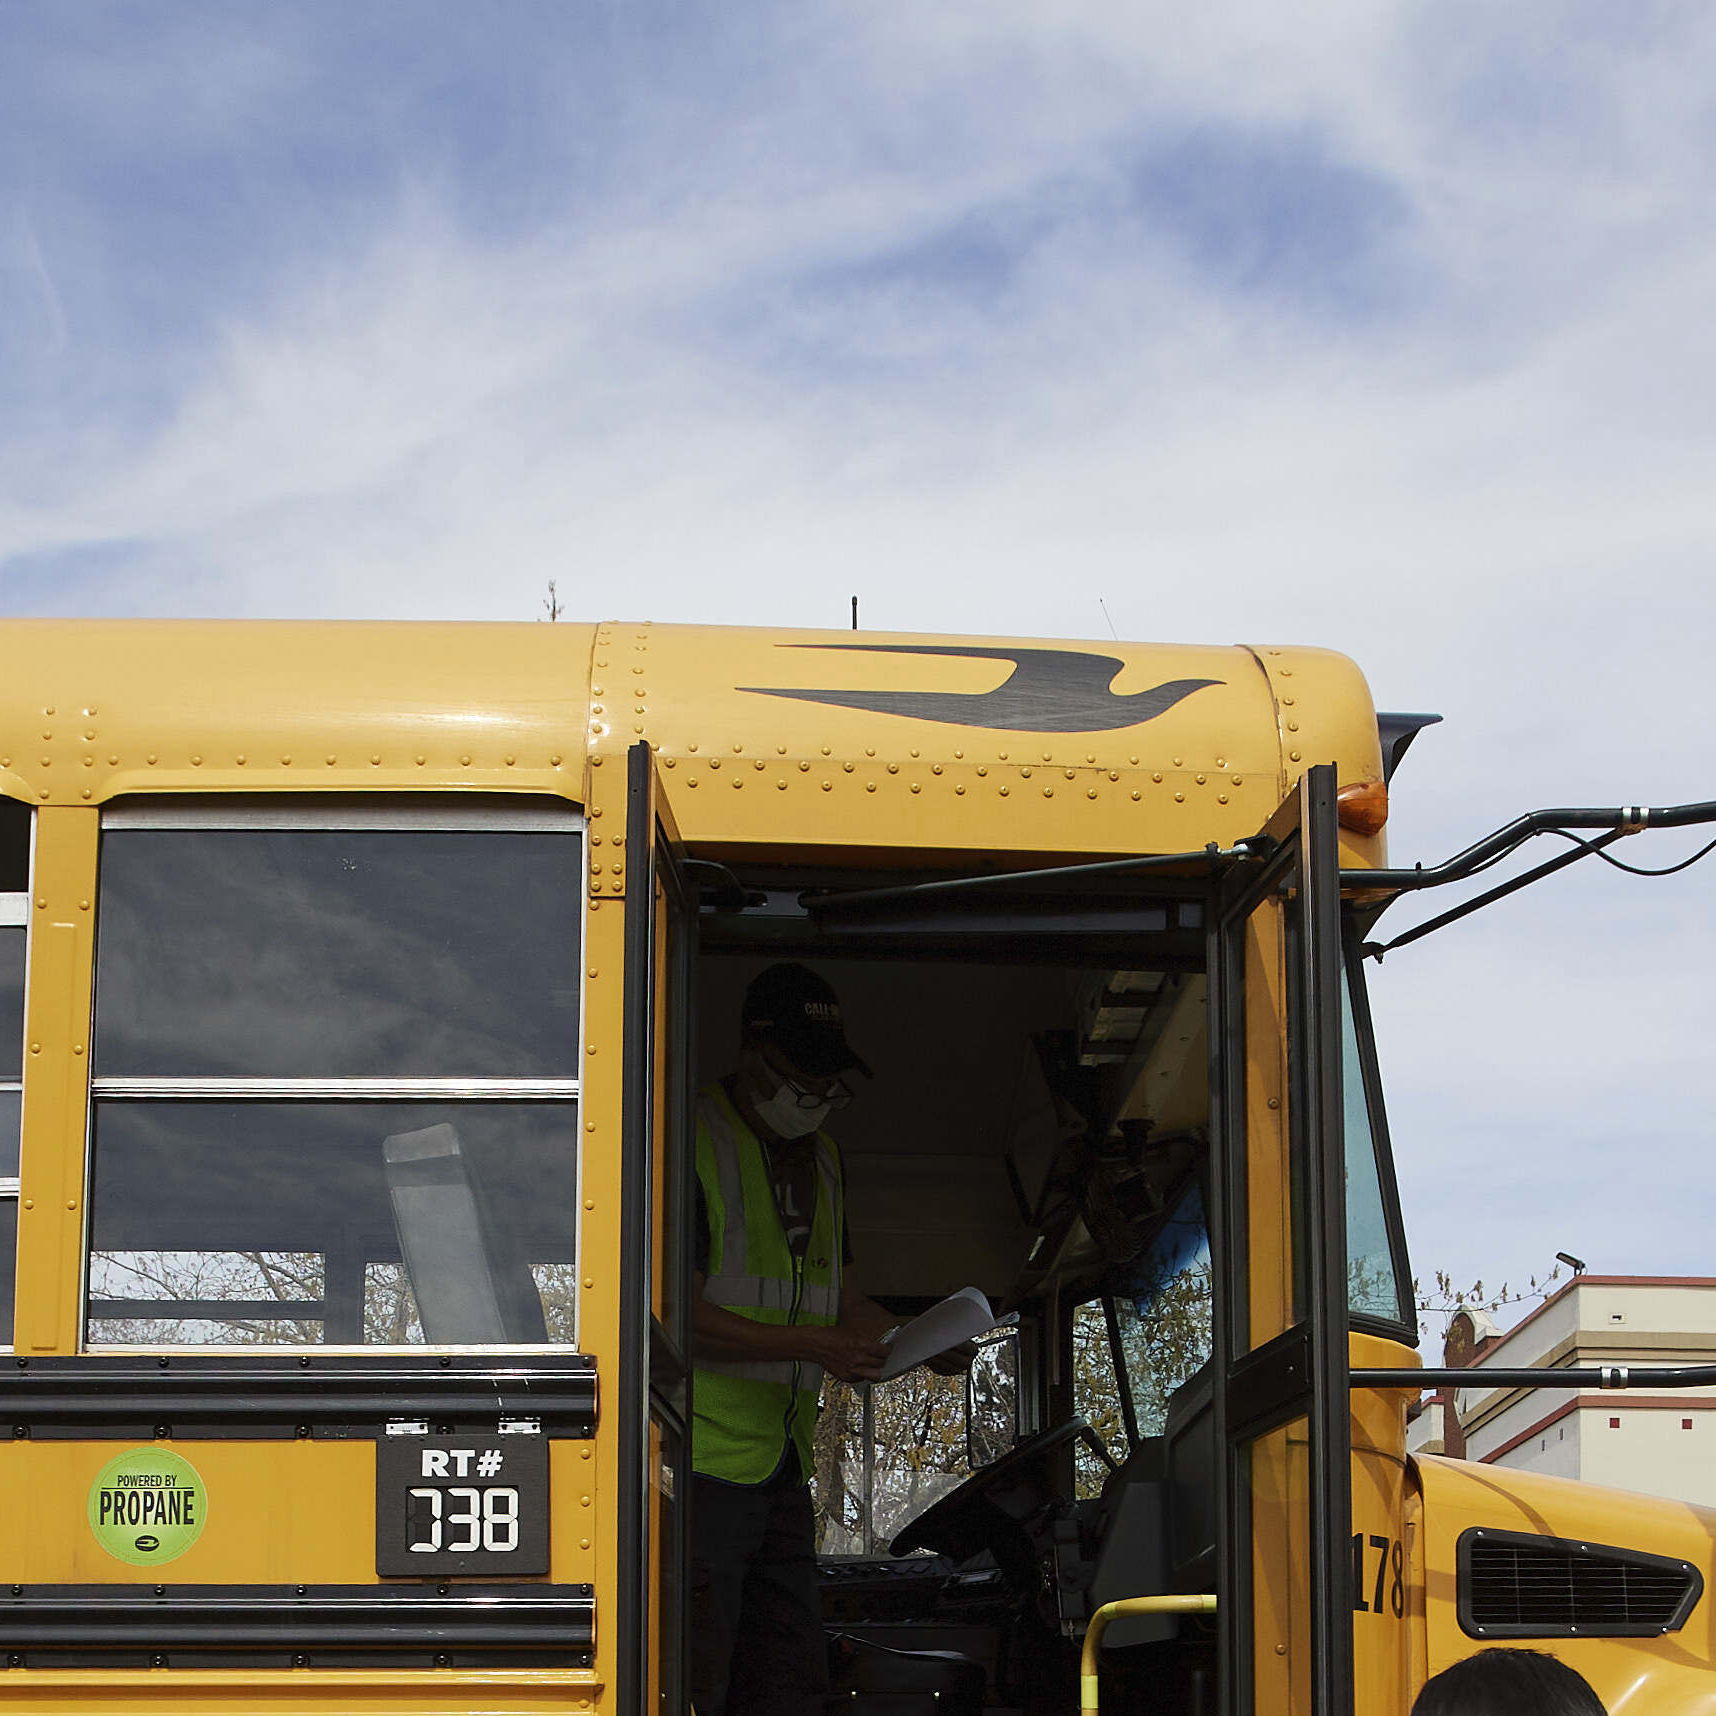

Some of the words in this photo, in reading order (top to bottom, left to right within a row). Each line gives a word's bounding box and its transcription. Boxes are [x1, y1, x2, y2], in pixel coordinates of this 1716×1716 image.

[421, 1449, 504, 1477] RT#
[117, 1474, 162, 1487] POWERED
[165, 1474, 177, 1487] BY
[99, 1490, 195, 1526] PROPANE
